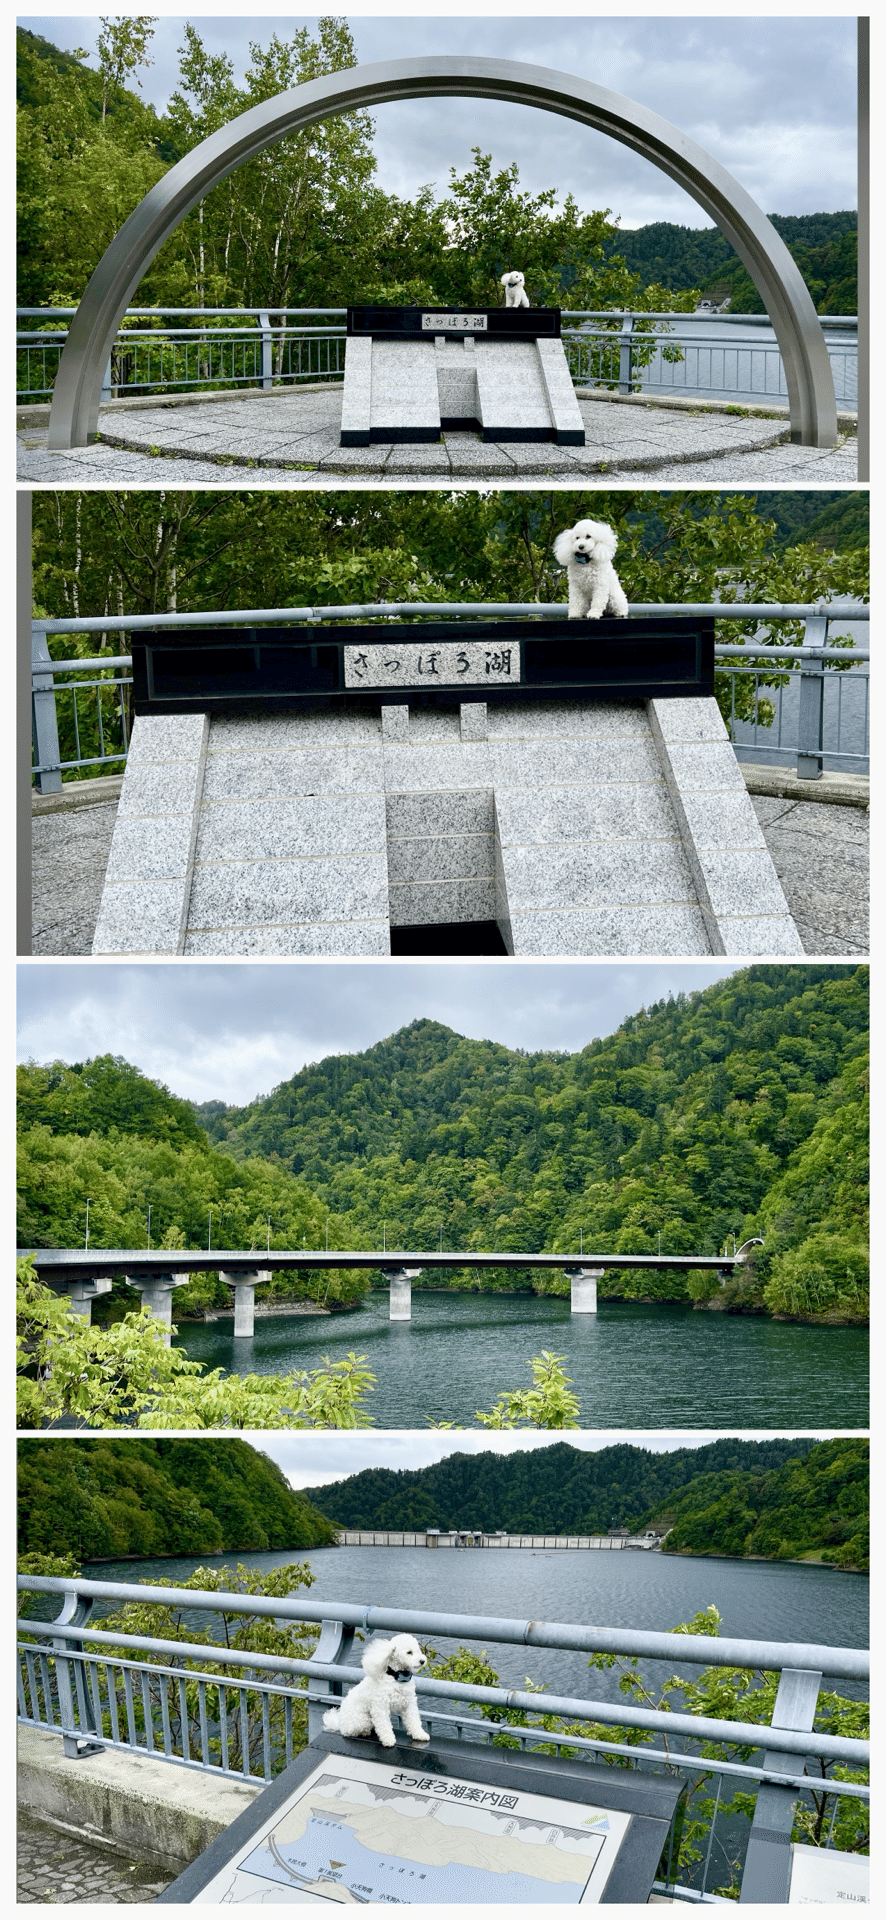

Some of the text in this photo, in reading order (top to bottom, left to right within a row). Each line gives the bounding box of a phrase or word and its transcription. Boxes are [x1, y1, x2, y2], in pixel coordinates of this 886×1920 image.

[425, 316, 485, 328] さっぽろ湖
[354, 649, 512, 678] さっぽろ湖
[391, 1773, 519, 1809] さっぽろ湖案内図
[836, 1890, 870, 1904] 定山渓
